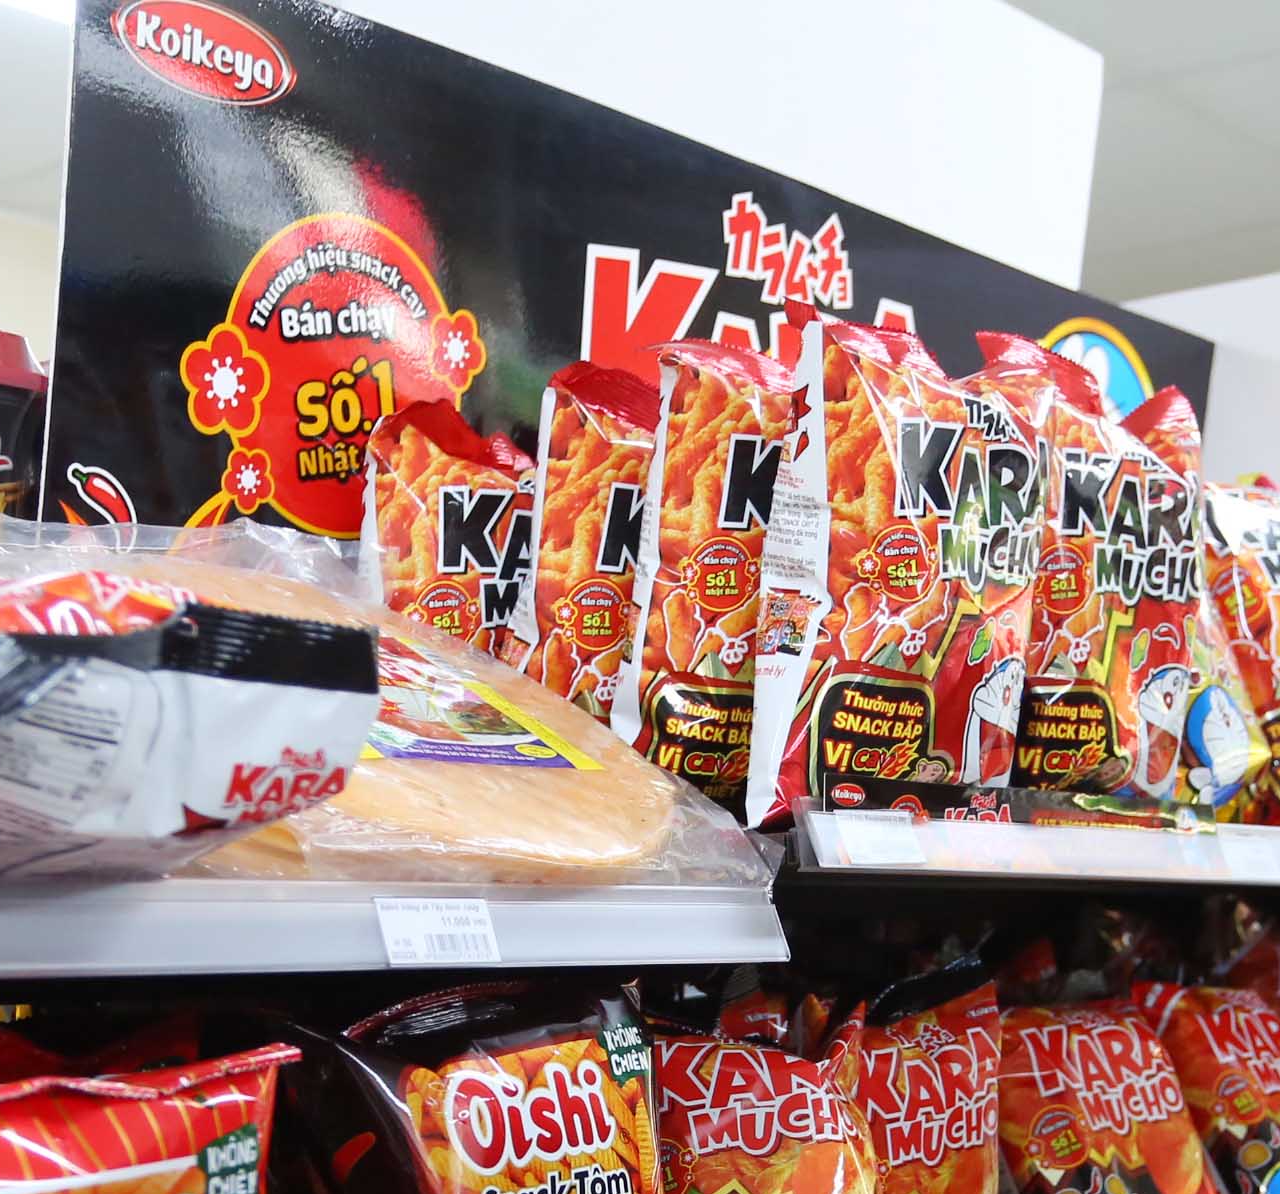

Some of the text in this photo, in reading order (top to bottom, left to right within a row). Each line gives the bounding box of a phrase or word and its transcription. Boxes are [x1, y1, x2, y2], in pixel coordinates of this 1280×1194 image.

[135, 10, 276, 92] Koikeya
[248, 242, 428, 328] Thương hiệu snack cay
[280, 300, 397, 340] Bán chạy
[298, 441, 361, 480] Nhật
[843, 689, 925, 717] Thưởng thức
[1080, 704, 1104, 720] thức
[666, 717, 725, 742] SNACK
[833, 711, 924, 740] SNACK BẮP
[1027, 720, 1107, 741] SNACK BẮP
[658, 743, 683, 776] Vị
[824, 740, 851, 776] Vị
[1018, 746, 1042, 775] Vị
[224, 763, 348, 807] KARA
[604, 1021, 642, 1054] KHÔNG
[609, 1049, 650, 1076] CHIÊN
[656, 1041, 833, 1112] KAR
[859, 1026, 1001, 1122] KARA
[1020, 1017, 1175, 1098] KARA
[450, 1063, 614, 1172] Oishi
[1077, 1072, 1184, 1136] MUCHO
[205, 1131, 257, 1168] KHÔNG
[886, 1096, 999, 1166] MUCHO
